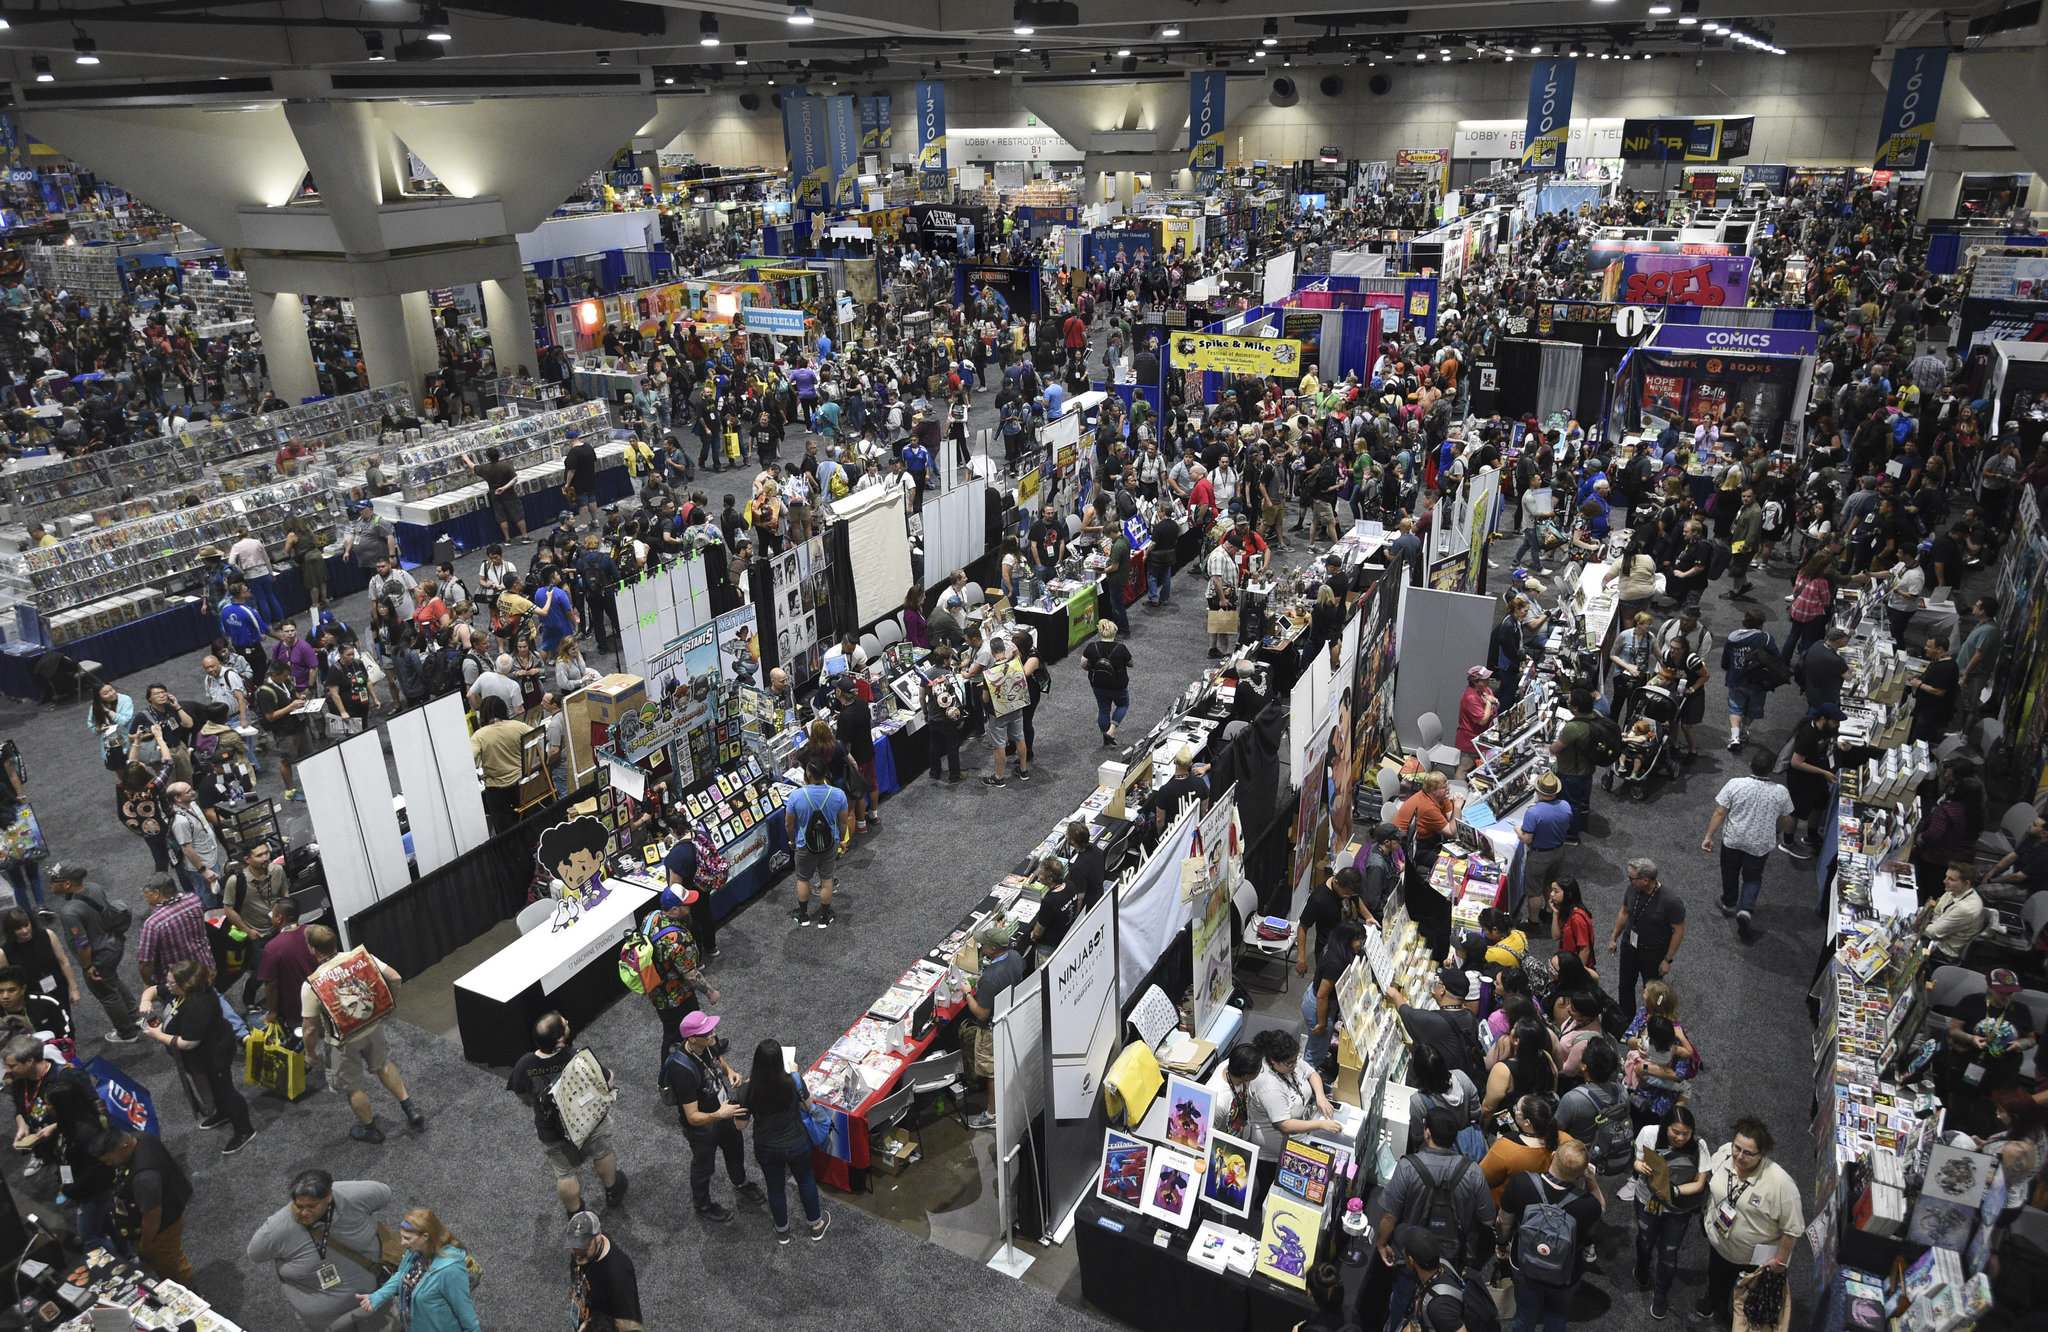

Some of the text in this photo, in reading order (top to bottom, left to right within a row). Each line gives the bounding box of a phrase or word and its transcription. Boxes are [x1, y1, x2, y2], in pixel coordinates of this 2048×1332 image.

[1900, 54, 1925, 129] 1600
[1540, 64, 1557, 132] 1500
[1201, 76, 1211, 136] 1400
[926, 85, 936, 140] 1300
[1465, 130, 1499, 141] LOBBY
[965, 137, 989, 146] LOBBY
[997, 137, 1047, 146] RESTROOMS
[1510, 141, 1523, 149] B1
[12, 170, 32, 181] 600
[618, 173, 639, 184] 1100
[926, 175, 945, 187] 1300
[933, 210, 956, 219] STORY
[934, 217, 957, 226] ATTIC
[1167, 222, 1189, 231] MARVEL
[749, 315, 801, 327] DUMBRELLA
[1705, 332, 1771, 347] COMICS
[1199, 340, 1272, 352] Spike & Mike
[1729, 363, 1772, 373] BOOKS
[1646, 376, 1676, 386] HOPE
[1649, 384, 1673, 392] NEVER
[1057, 923, 1105, 992] NINJABOT
